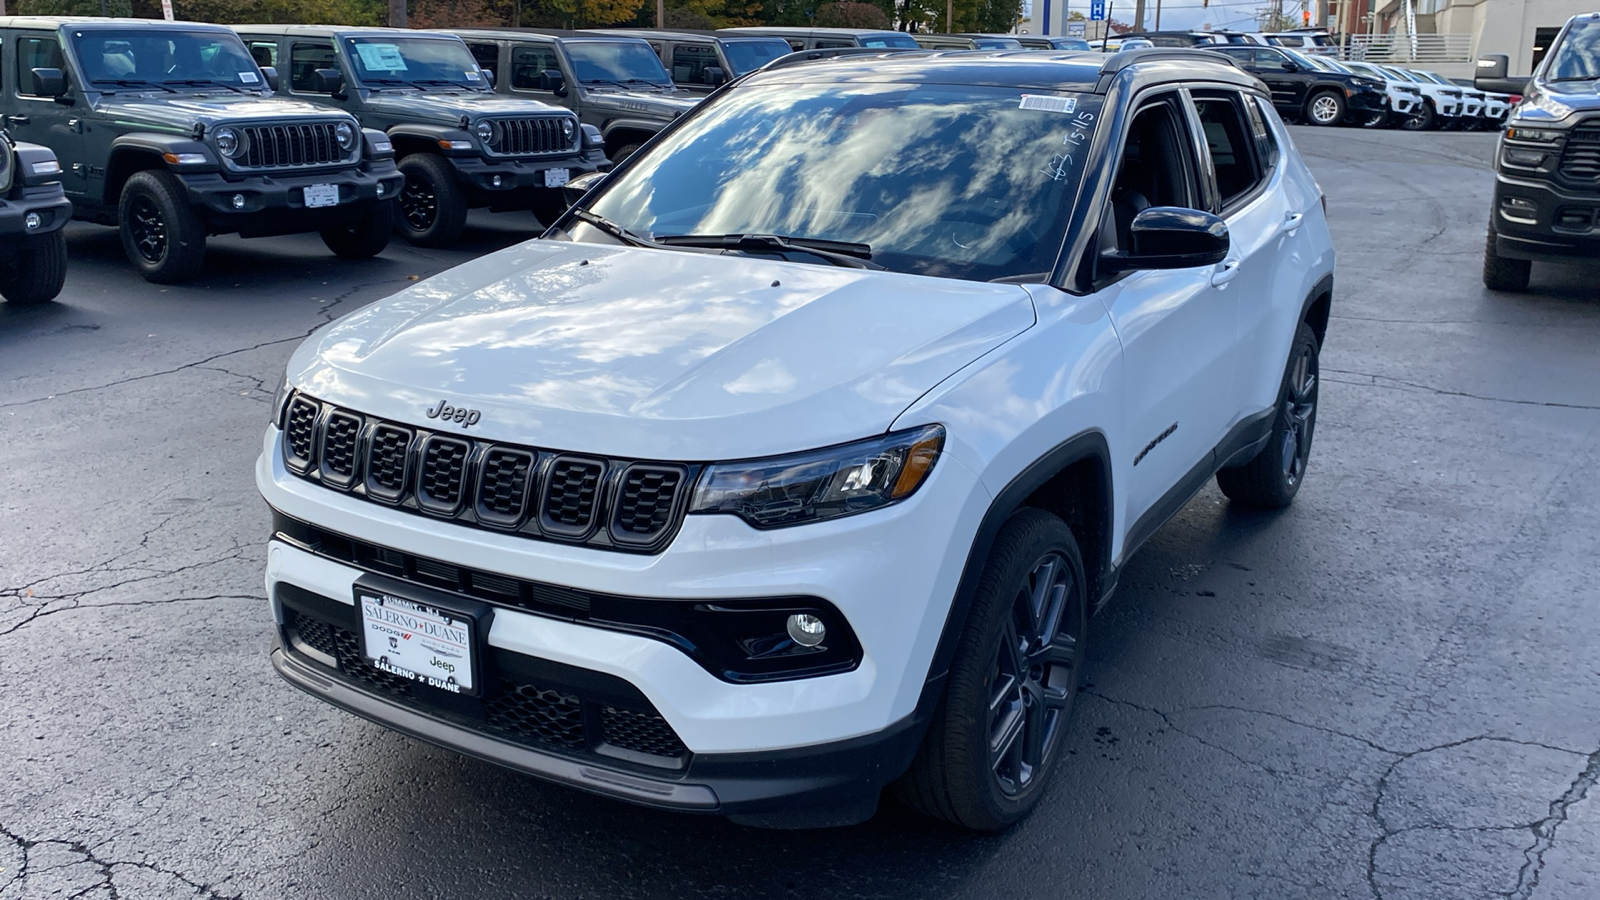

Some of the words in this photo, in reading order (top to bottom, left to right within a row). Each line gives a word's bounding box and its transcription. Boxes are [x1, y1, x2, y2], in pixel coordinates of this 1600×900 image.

[1093, 4, 1102, 15] H
[426, 399, 481, 428] Jeep
[365, 604, 418, 630] SALERNO
[424, 621, 467, 646] DUANE
[371, 624, 405, 638] DODGE
[374, 660, 416, 680] SALERNO
[428, 677, 461, 692] DUANE
[429, 656, 455, 673] Jeep
